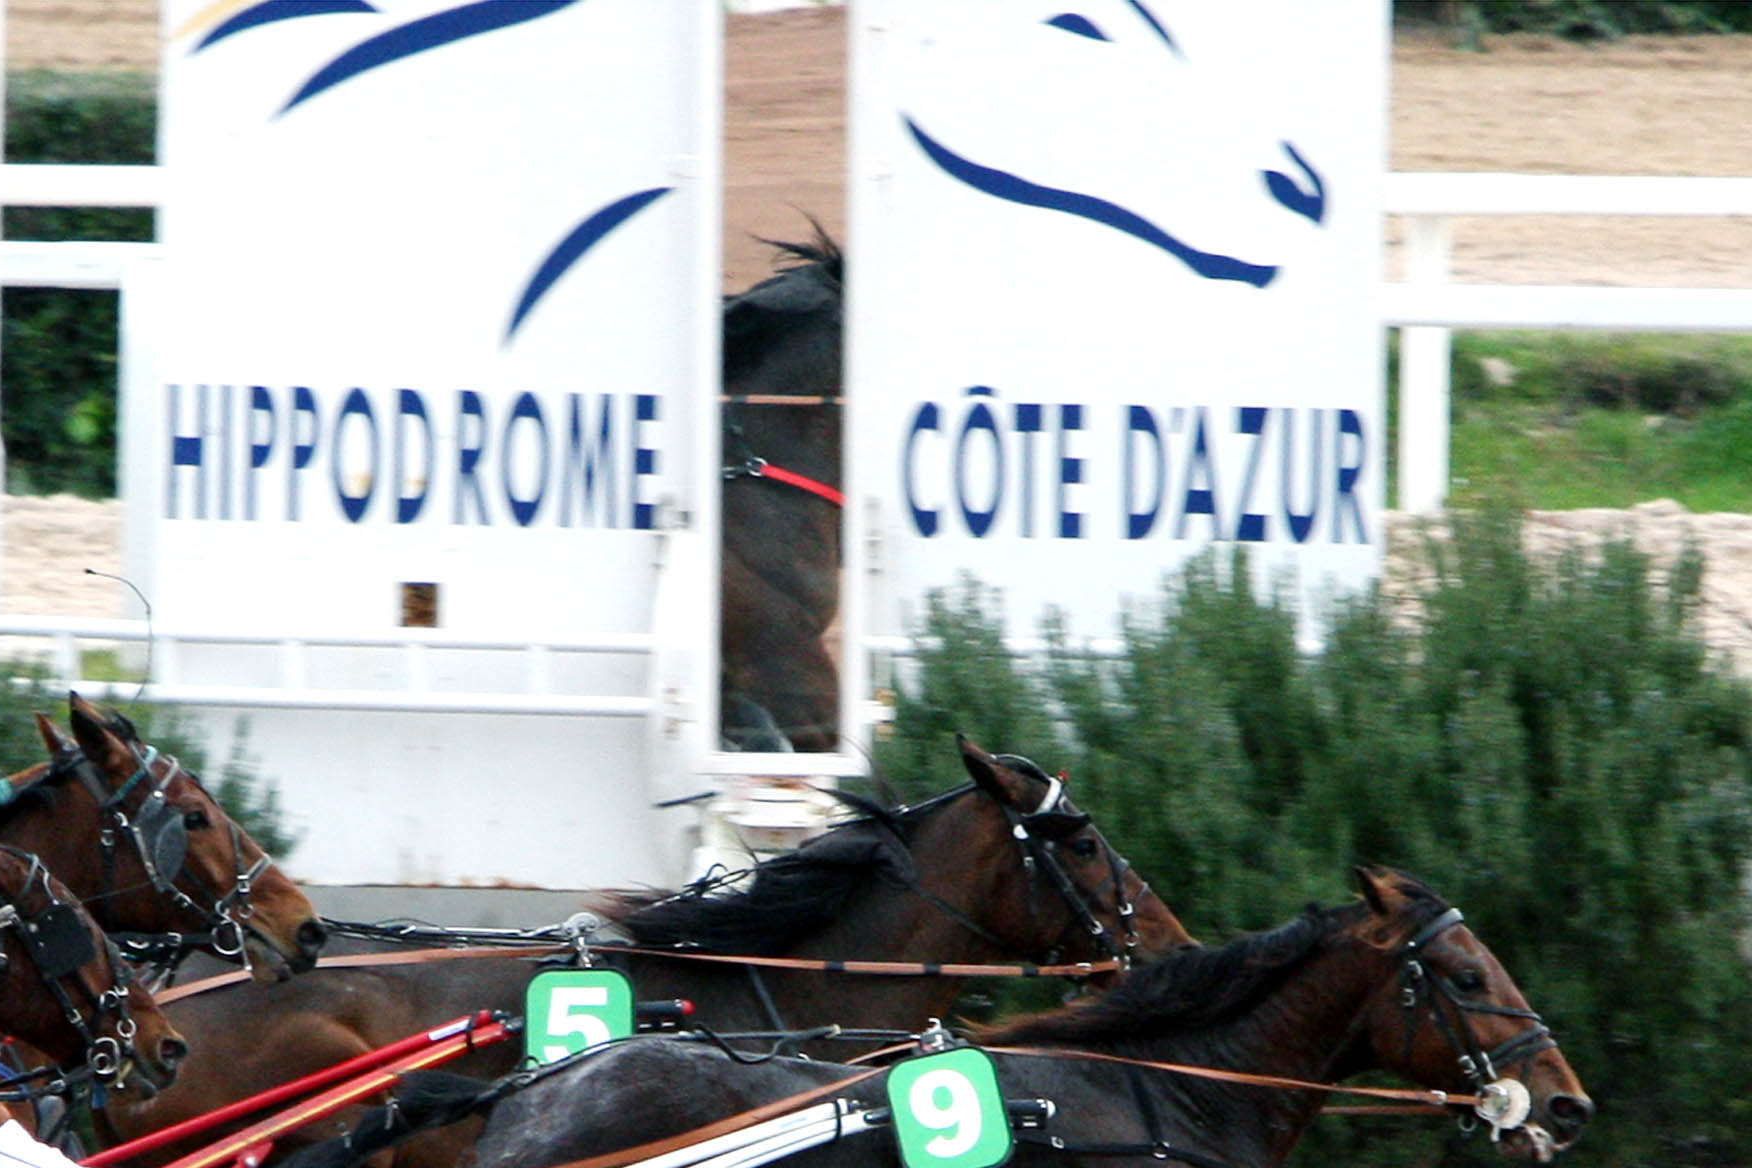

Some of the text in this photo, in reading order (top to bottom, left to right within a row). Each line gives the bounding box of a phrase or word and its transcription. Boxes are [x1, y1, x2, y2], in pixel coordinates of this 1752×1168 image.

[165, 383, 662, 530] HIPPODROME
[900, 385, 1374, 545] CÔTE D'AZUR
[544, 987, 611, 1065] 5
[909, 1069, 982, 1158] 9
